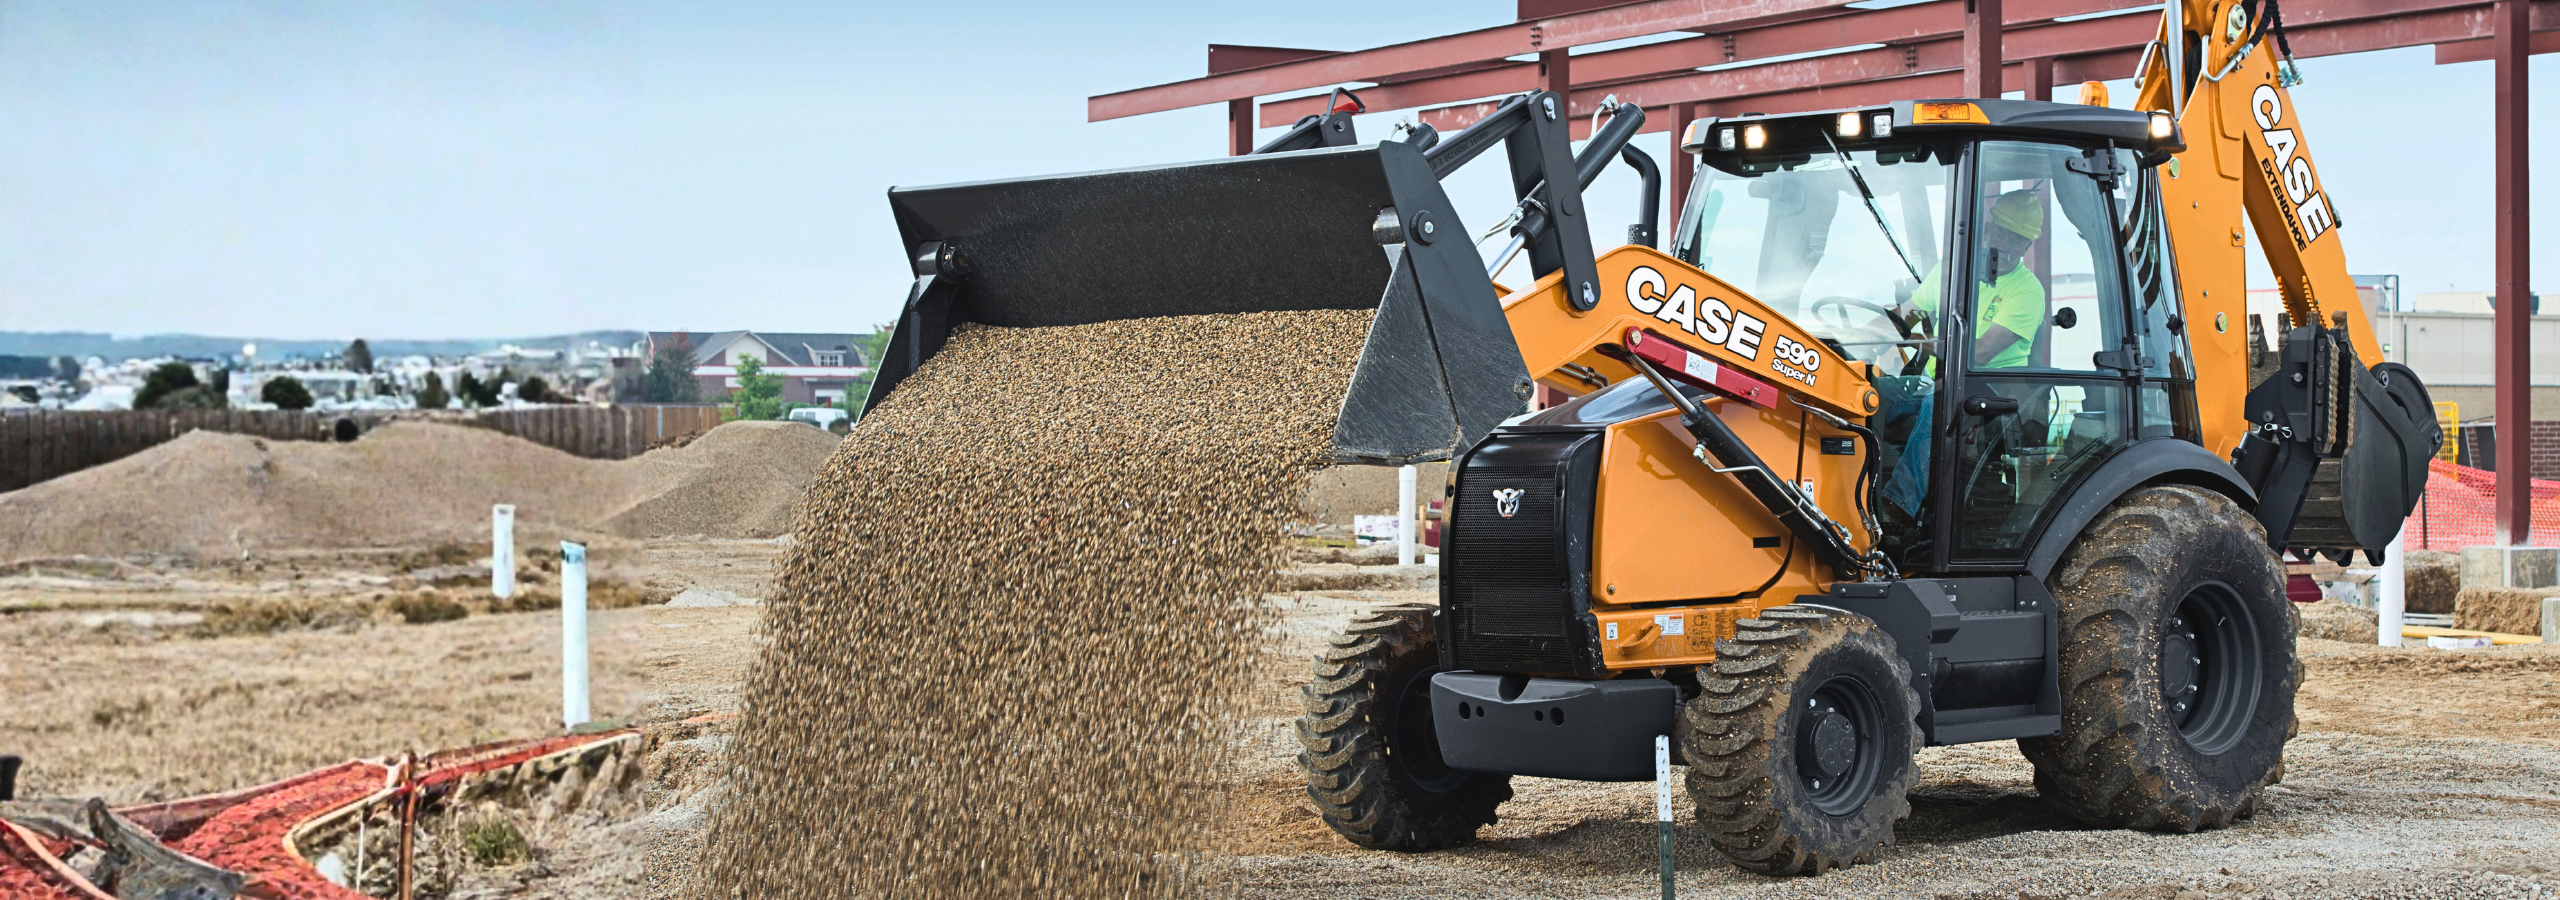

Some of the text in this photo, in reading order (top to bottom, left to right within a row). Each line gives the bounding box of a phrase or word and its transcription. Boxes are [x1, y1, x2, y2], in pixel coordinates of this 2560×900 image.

[2251, 84, 2333, 243] CASE
[2261, 158, 2307, 252] EXTENDAHOE
[1626, 265, 1767, 362] CASE
[1774, 334, 1821, 372] 590
[1771, 357, 1817, 387] Super N
